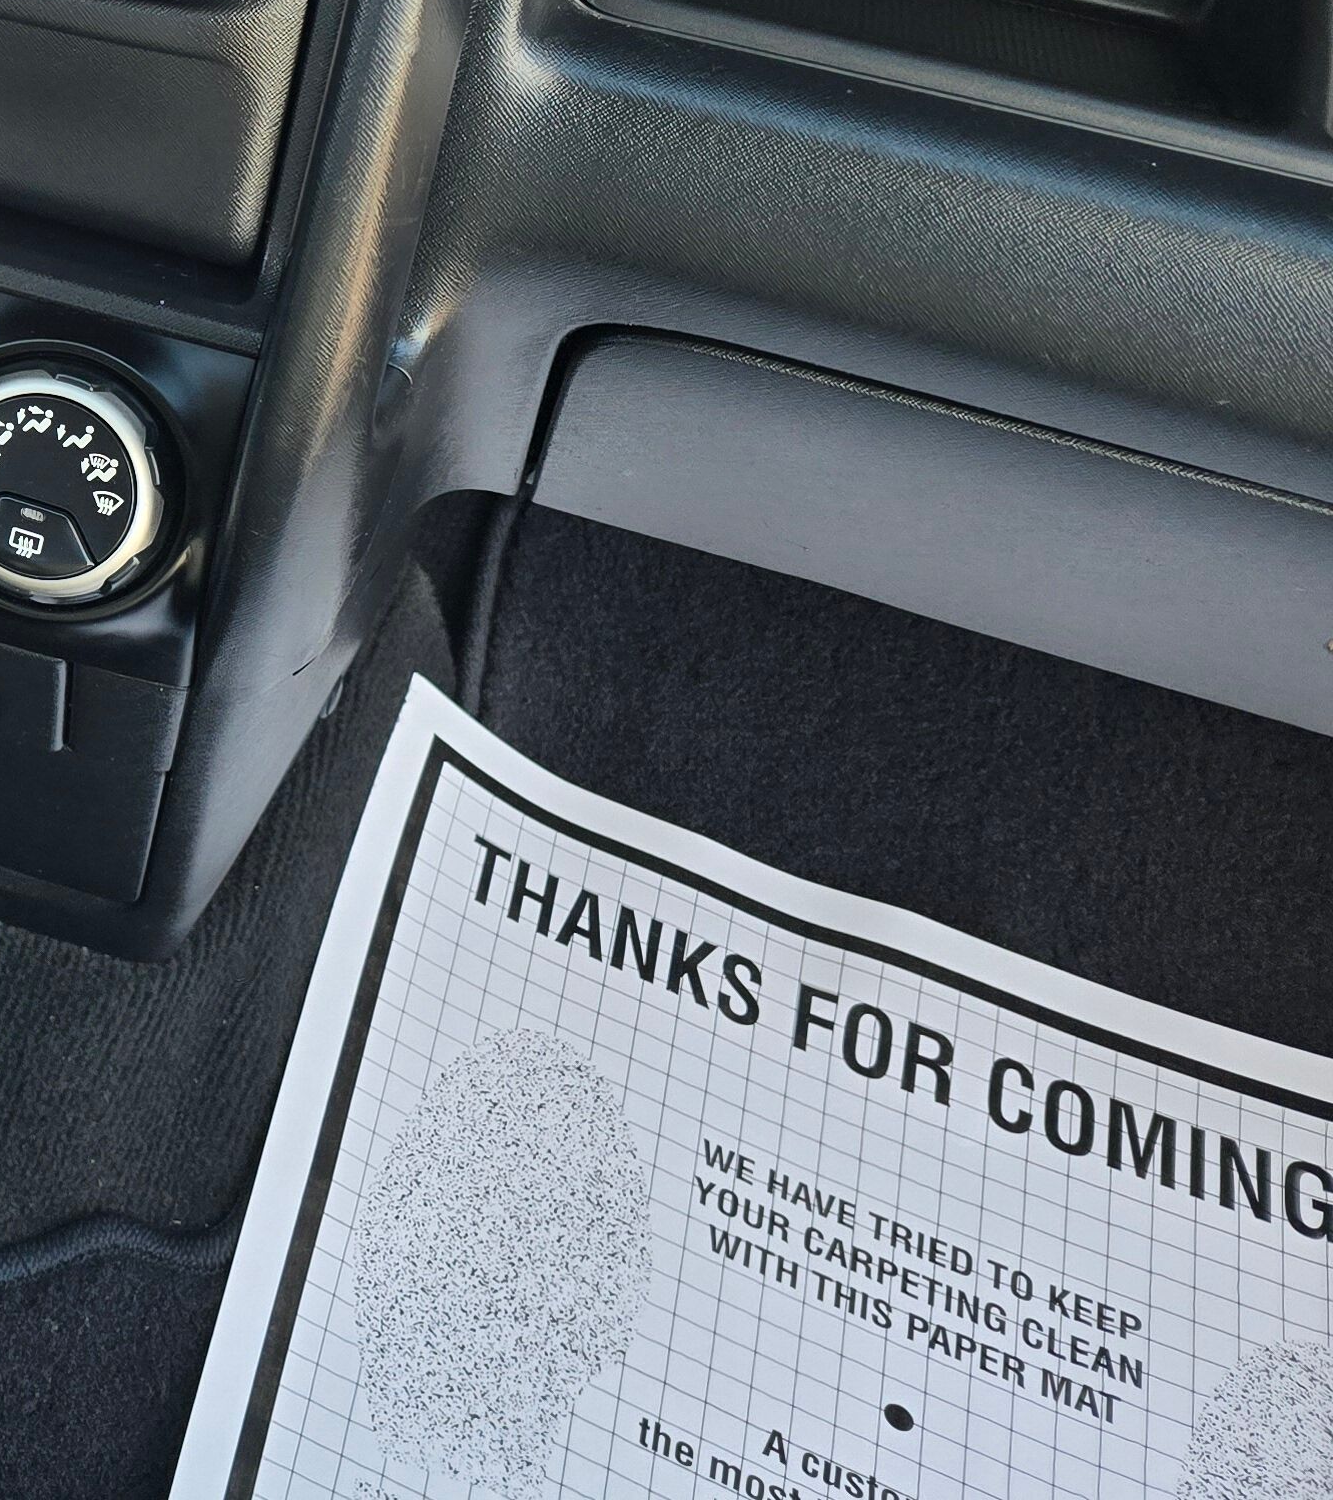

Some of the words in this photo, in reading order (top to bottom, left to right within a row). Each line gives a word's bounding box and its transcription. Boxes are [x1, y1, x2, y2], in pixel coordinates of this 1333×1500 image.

[473, 834, 763, 1026] THANKS
[792, 981, 955, 1109] FOR
[988, 1057, 1333, 1244] COMING
[694, 1175, 790, 1244] YOUR
[803, 1226, 1007, 1335] CARPETING
[1022, 1317, 1143, 1390] CLEAN
[703, 1138, 756, 1186] WE
[767, 1168, 856, 1230] HAVE
[868, 1211, 973, 1277] TRIED
[987, 1259, 1033, 1302] TO
[1048, 1284, 1142, 1340] KEEP
[709, 1224, 799, 1290] WITH
[811, 1270, 893, 1330] THIS
[906, 1312, 1026, 1390] PAPER
[1041, 1368, 1122, 1425] MAT
[638, 1416, 694, 1468] the
[762, 1428, 788, 1466] A
